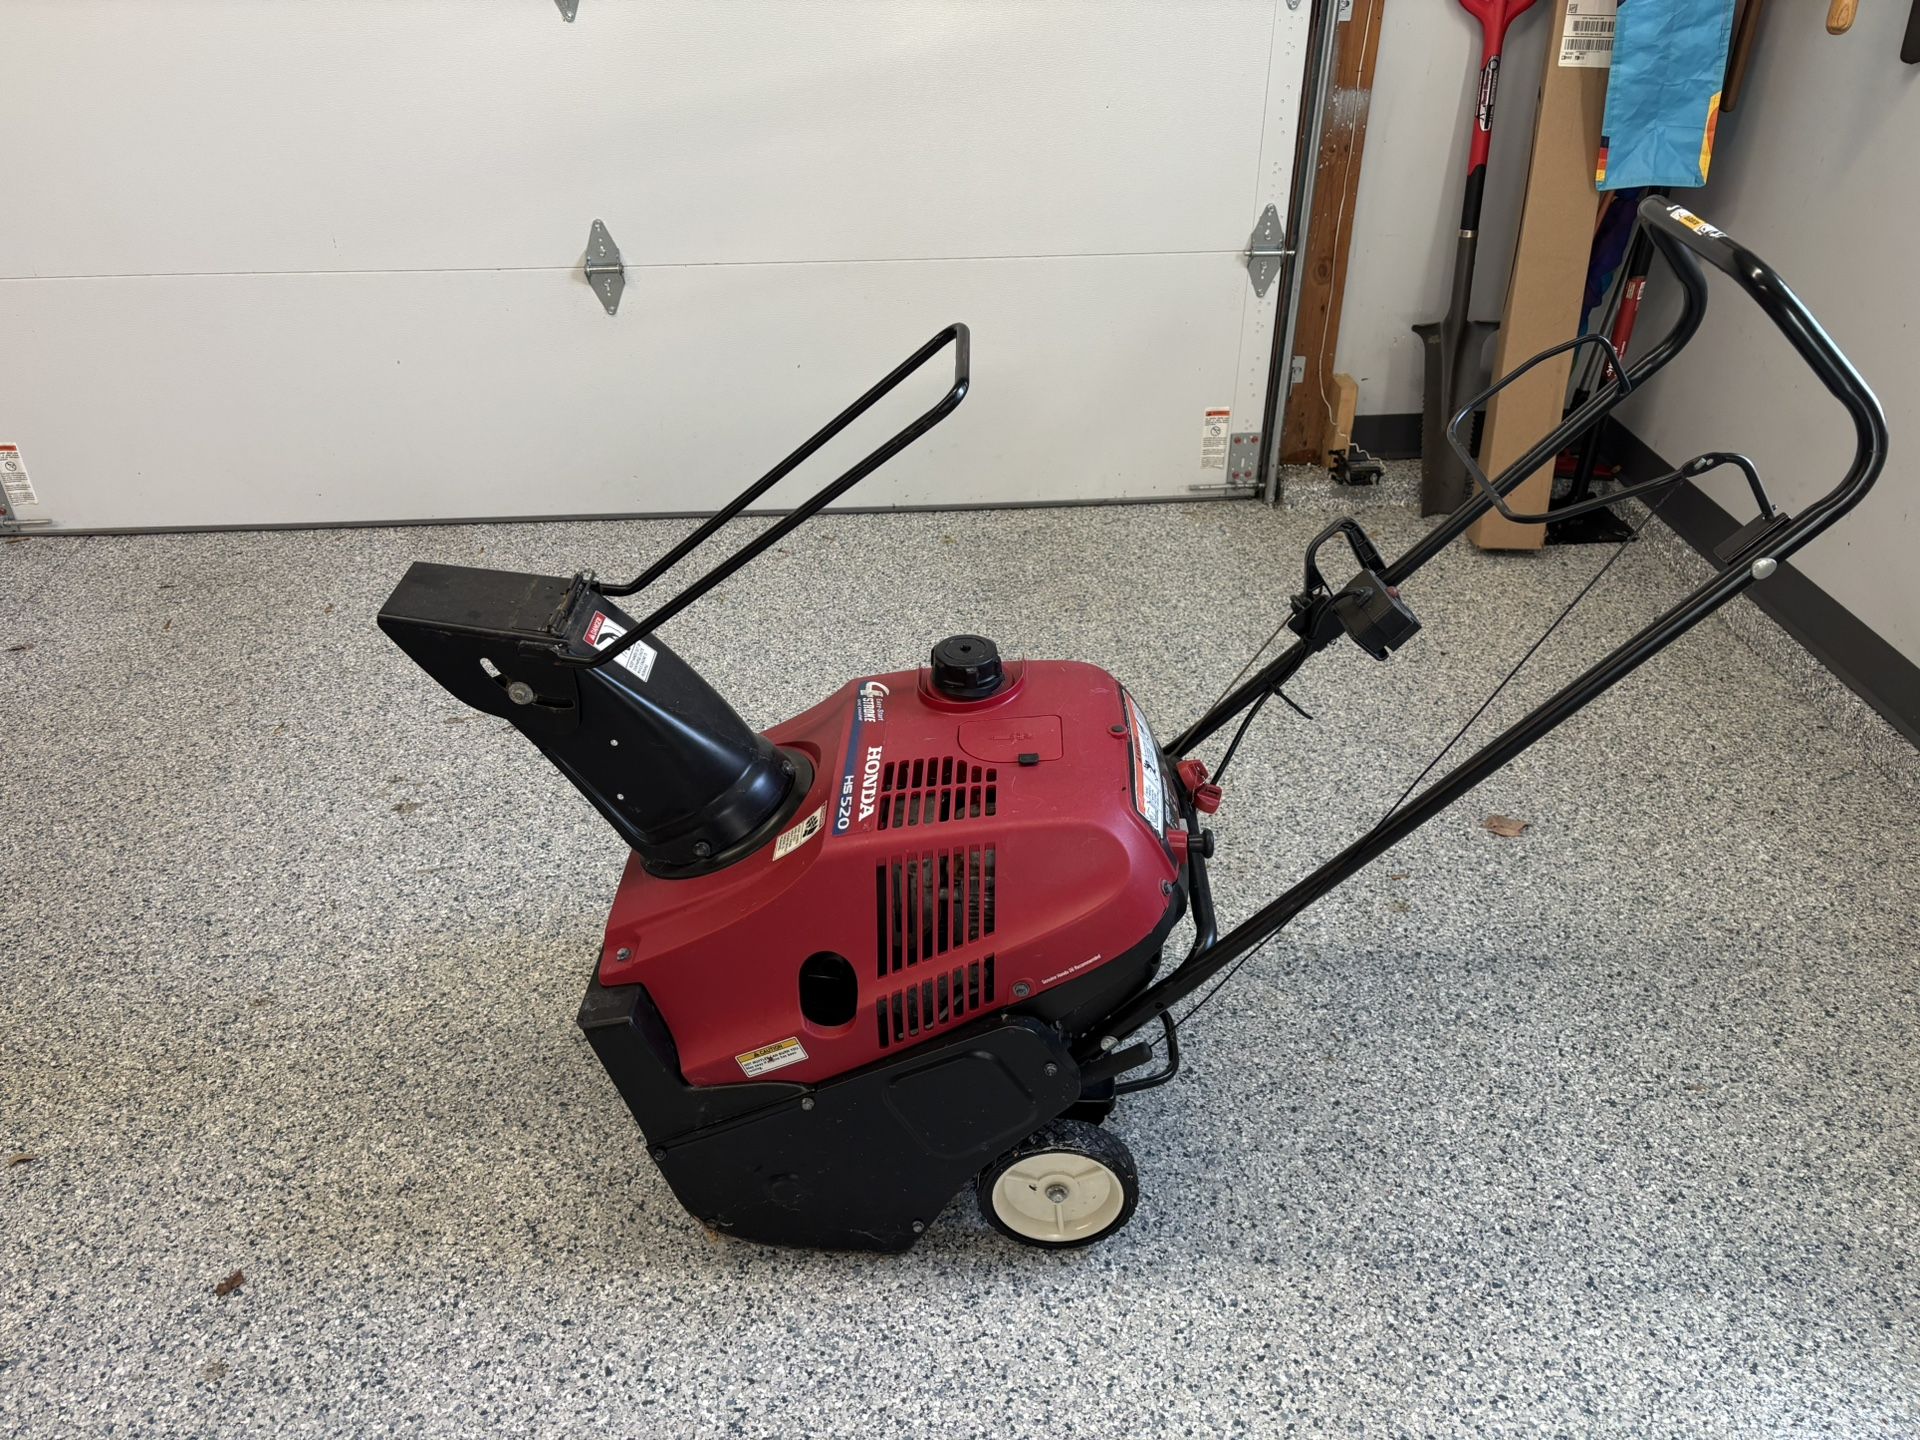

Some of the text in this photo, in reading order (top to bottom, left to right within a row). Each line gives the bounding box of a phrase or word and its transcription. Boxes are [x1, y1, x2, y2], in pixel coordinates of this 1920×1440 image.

[860, 682, 889, 722] 4 STROKE
[858, 746, 882, 822] HONDA
[1074, 954, 1101, 970] Recommended
[759, 1044, 783, 1055] CAUTION
